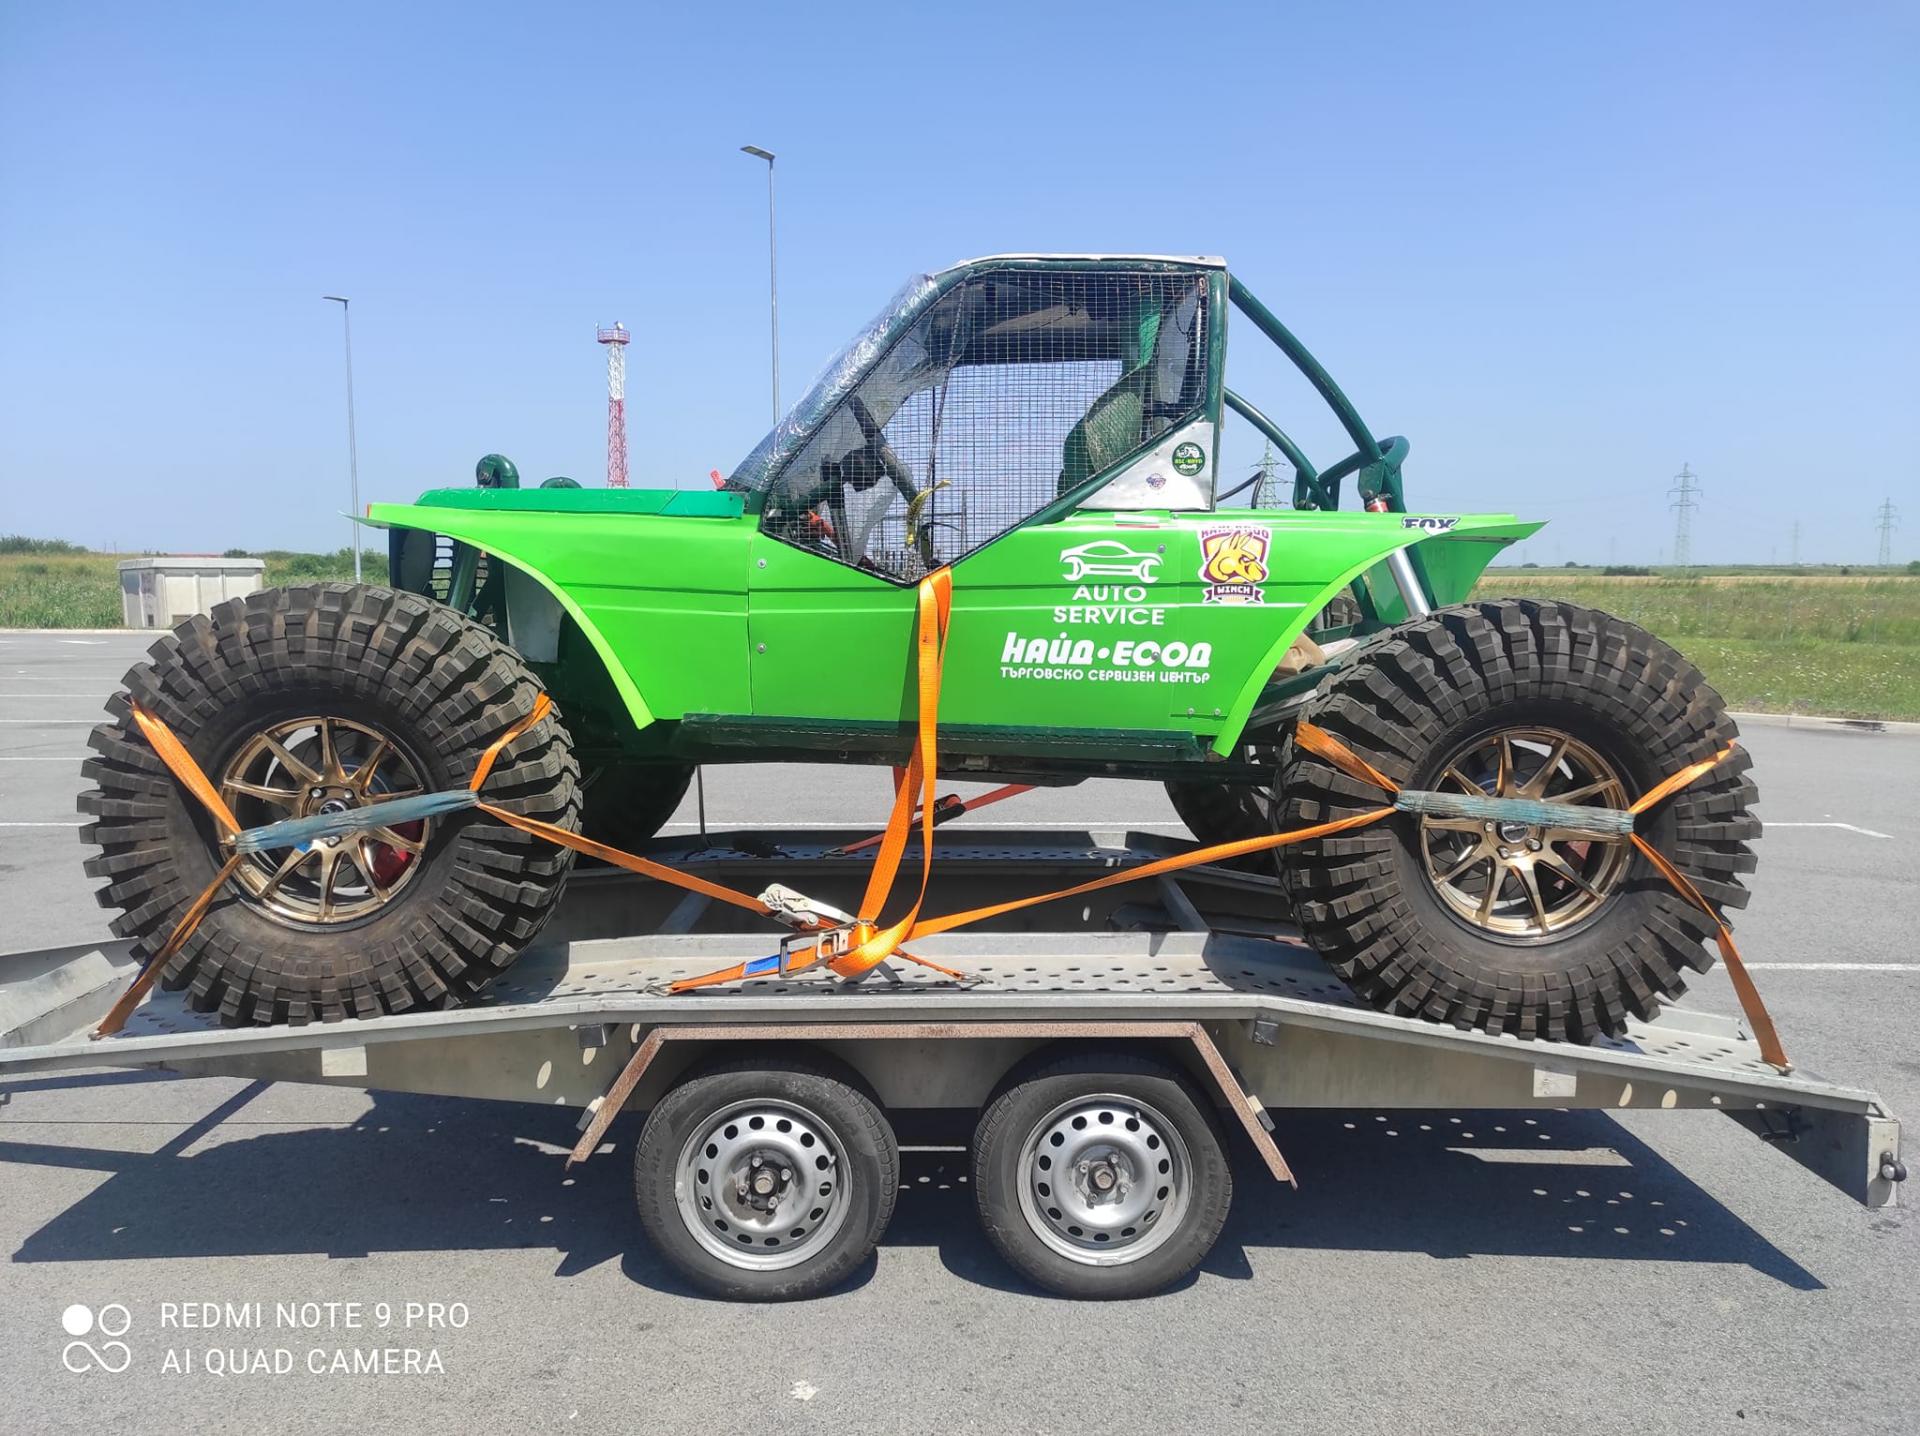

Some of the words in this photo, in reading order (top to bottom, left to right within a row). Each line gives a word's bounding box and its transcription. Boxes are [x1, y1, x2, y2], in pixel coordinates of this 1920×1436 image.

[1403, 517, 1458, 529] FOX
[1072, 585, 1147, 602] AUTO
[1217, 585, 1250, 594] WINCH
[1053, 606, 1165, 625] SERVICE
